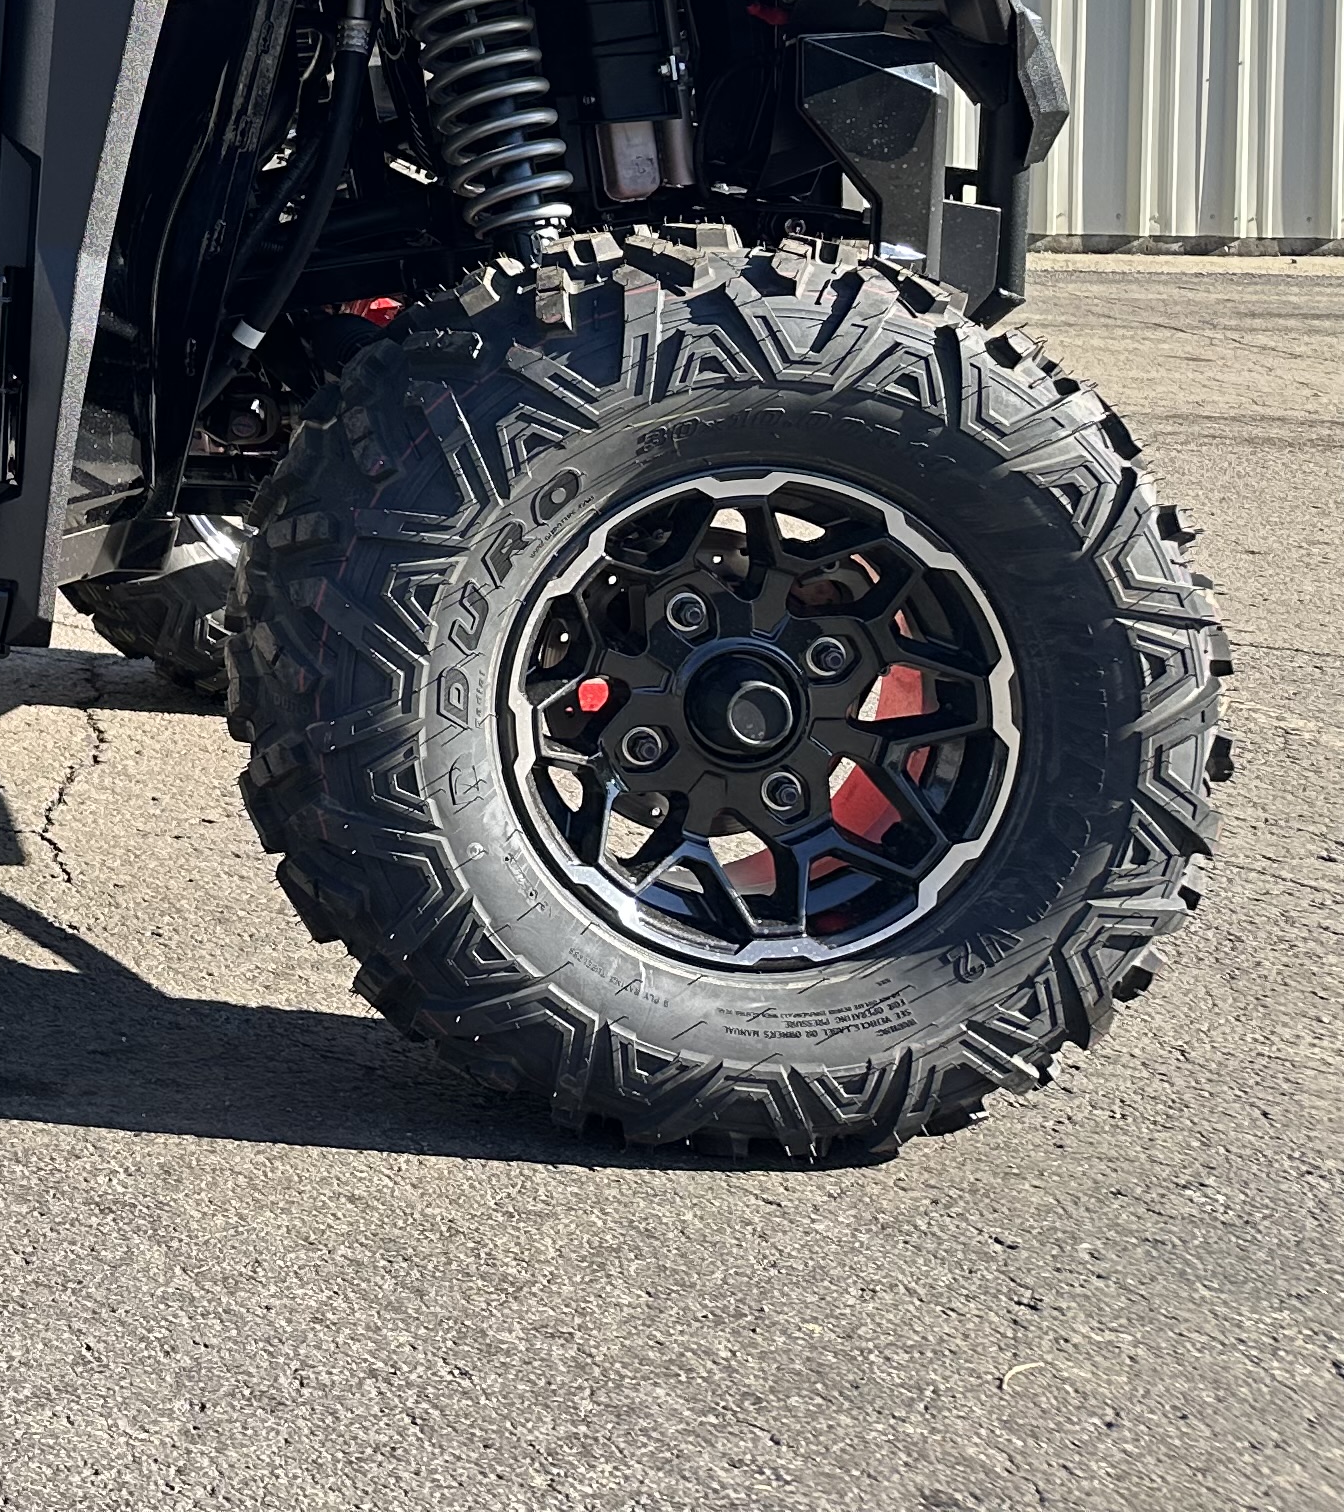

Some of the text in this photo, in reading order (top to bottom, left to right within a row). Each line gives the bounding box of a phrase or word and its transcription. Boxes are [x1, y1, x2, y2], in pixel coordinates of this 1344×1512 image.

[437, 469, 586, 731] DURO
[939, 925, 1026, 982] V2
[722, 1026, 760, 1038] MANUAL
